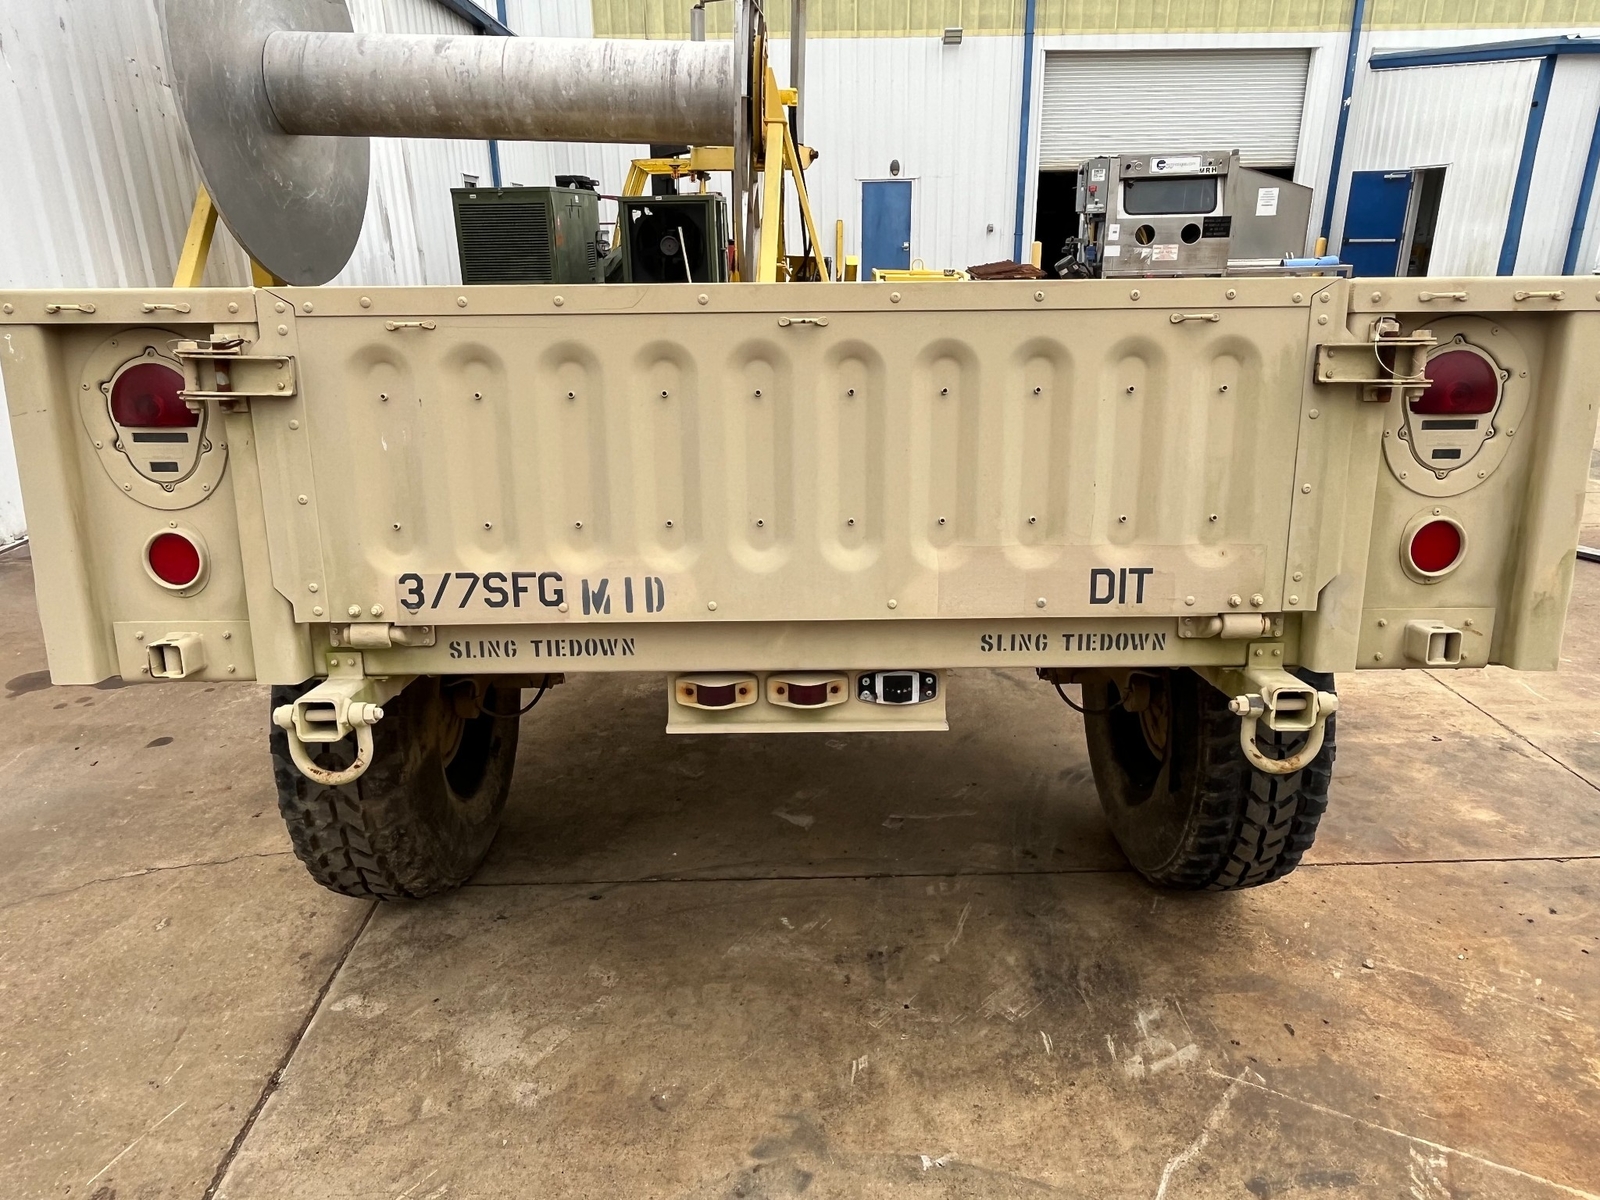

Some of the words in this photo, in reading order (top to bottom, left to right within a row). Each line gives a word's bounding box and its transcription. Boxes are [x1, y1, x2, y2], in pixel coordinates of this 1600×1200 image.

[398, 571, 564, 609] 3/7SFG
[581, 576, 665, 616] MID
[1089, 567, 1154, 605] DIT
[448, 639, 518, 659] SLING
[530, 637, 636, 658] TIEDOWN
[980, 633, 1048, 652] SLING
[1062, 632, 1166, 652] TIEDOWN
